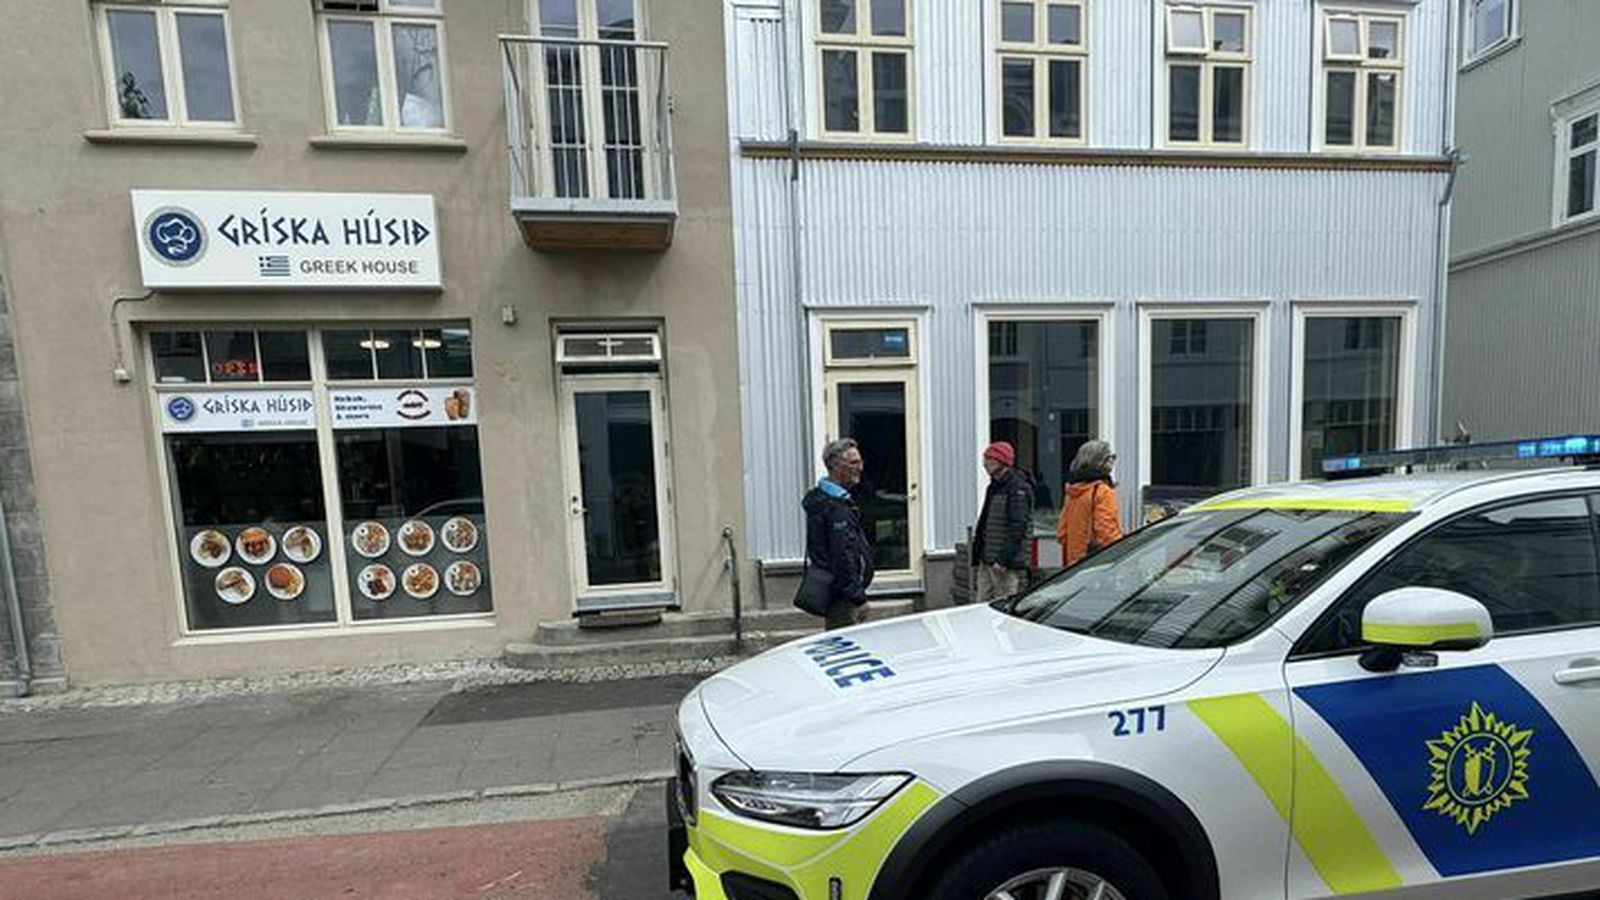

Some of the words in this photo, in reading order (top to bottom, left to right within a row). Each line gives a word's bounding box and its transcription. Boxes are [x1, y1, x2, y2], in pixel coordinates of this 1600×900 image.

[217, 207, 330, 247] GRÍSKA
[342, 208, 430, 246] HÚSIÐ
[300, 259, 357, 274] GREEK
[363, 259, 418, 274] HOUSE
[203, 394, 261, 414] GRÍSKA
[266, 393, 313, 412] HÚSIÐ
[799, 636, 896, 688] POLICE
[1108, 704, 1165, 736] 277
